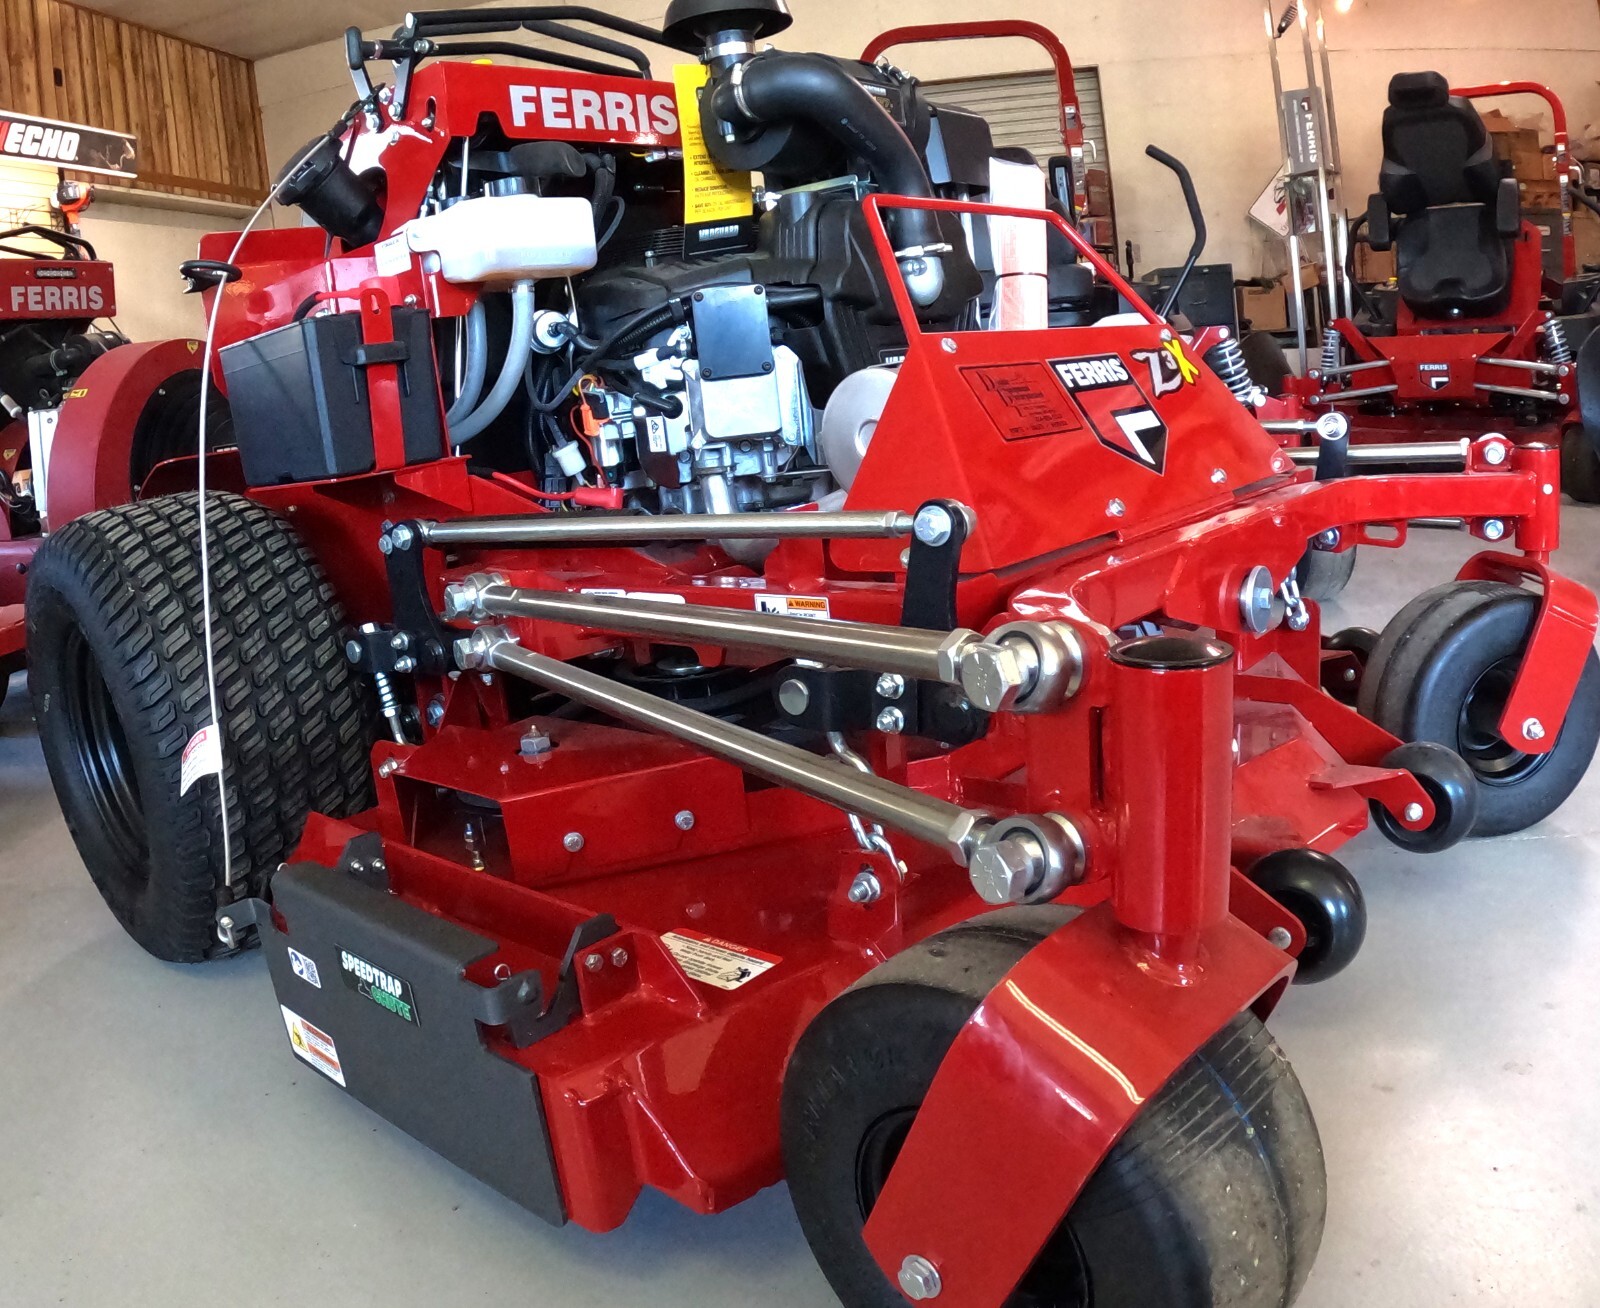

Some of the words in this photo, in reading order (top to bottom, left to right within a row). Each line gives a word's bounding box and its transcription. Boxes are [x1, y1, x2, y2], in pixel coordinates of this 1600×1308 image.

[508, 84, 678, 135] FERRIS
[4, 122, 80, 161] ECHO
[10, 285, 104, 312] FERRIS
[1055, 358, 1129, 388] FERRIS
[1419, 363, 1448, 371] FERRIS
[794, 599, 826, 609] WARNING
[710, 938, 750, 953] DANGER
[341, 950, 402, 998] SPEEDTRAP
